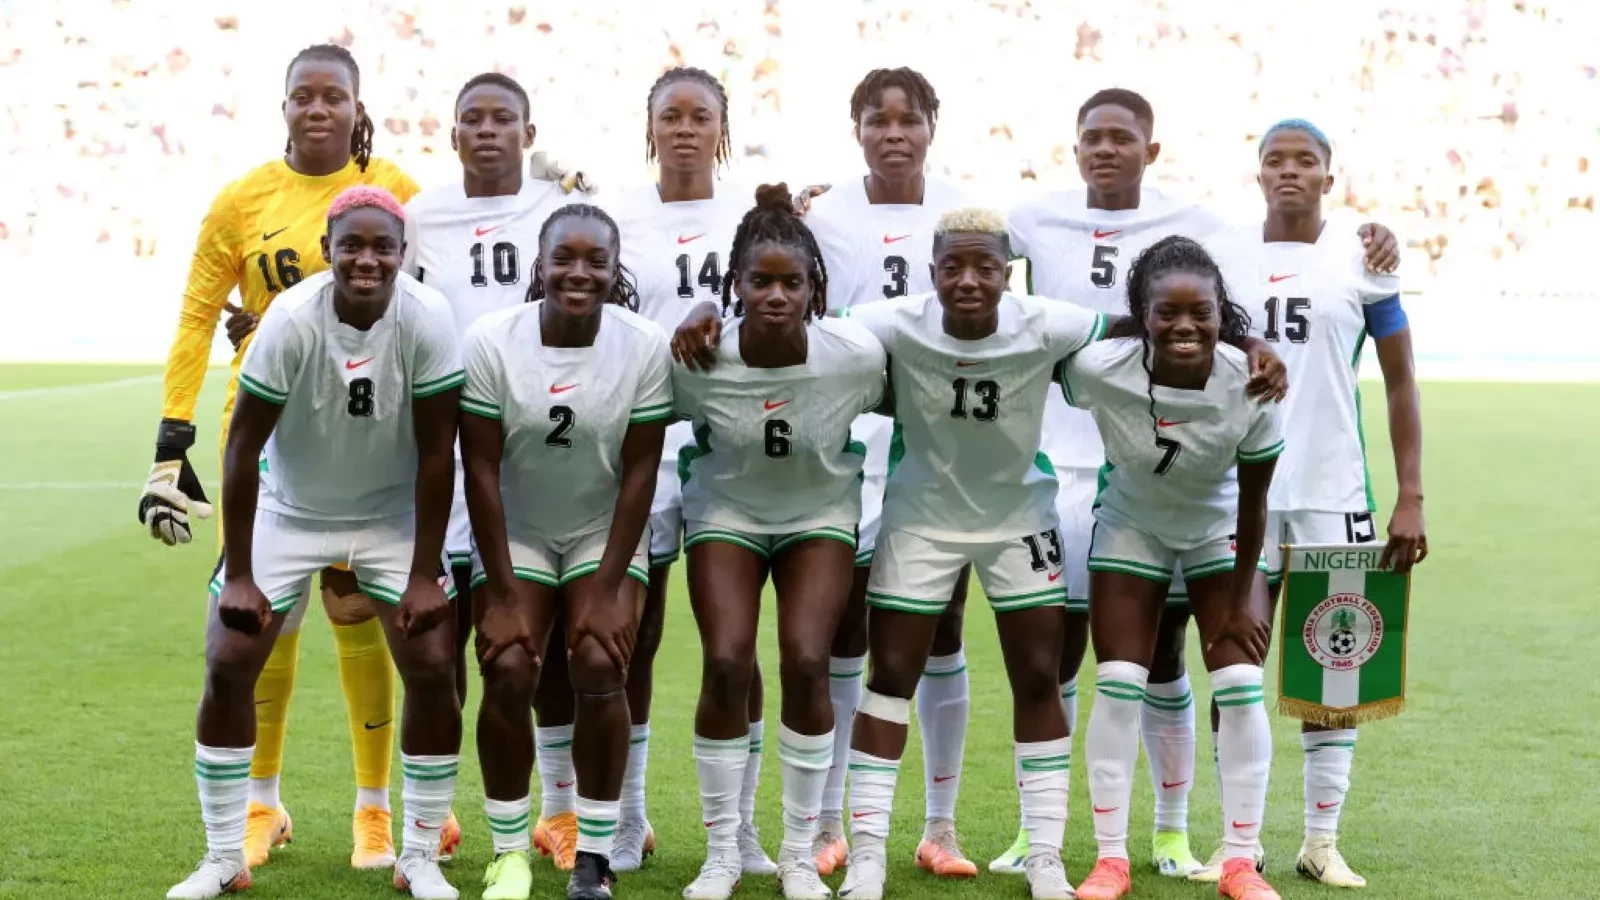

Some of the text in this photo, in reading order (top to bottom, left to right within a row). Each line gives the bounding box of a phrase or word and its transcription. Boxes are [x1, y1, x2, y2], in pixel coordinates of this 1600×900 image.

[258, 248, 303, 293] 16
[470, 242, 519, 287] 10
[676, 252, 722, 298] 14
[883, 256, 909, 298] 3
[1091, 246, 1119, 289] 5
[1264, 297, 1311, 343] 15
[348, 378, 374, 417] 8
[950, 378, 1000, 422] 13
[545, 405, 576, 448] 2
[764, 419, 793, 459] 6
[1153, 436, 1182, 476] 7
[1022, 529, 1063, 572] 13
